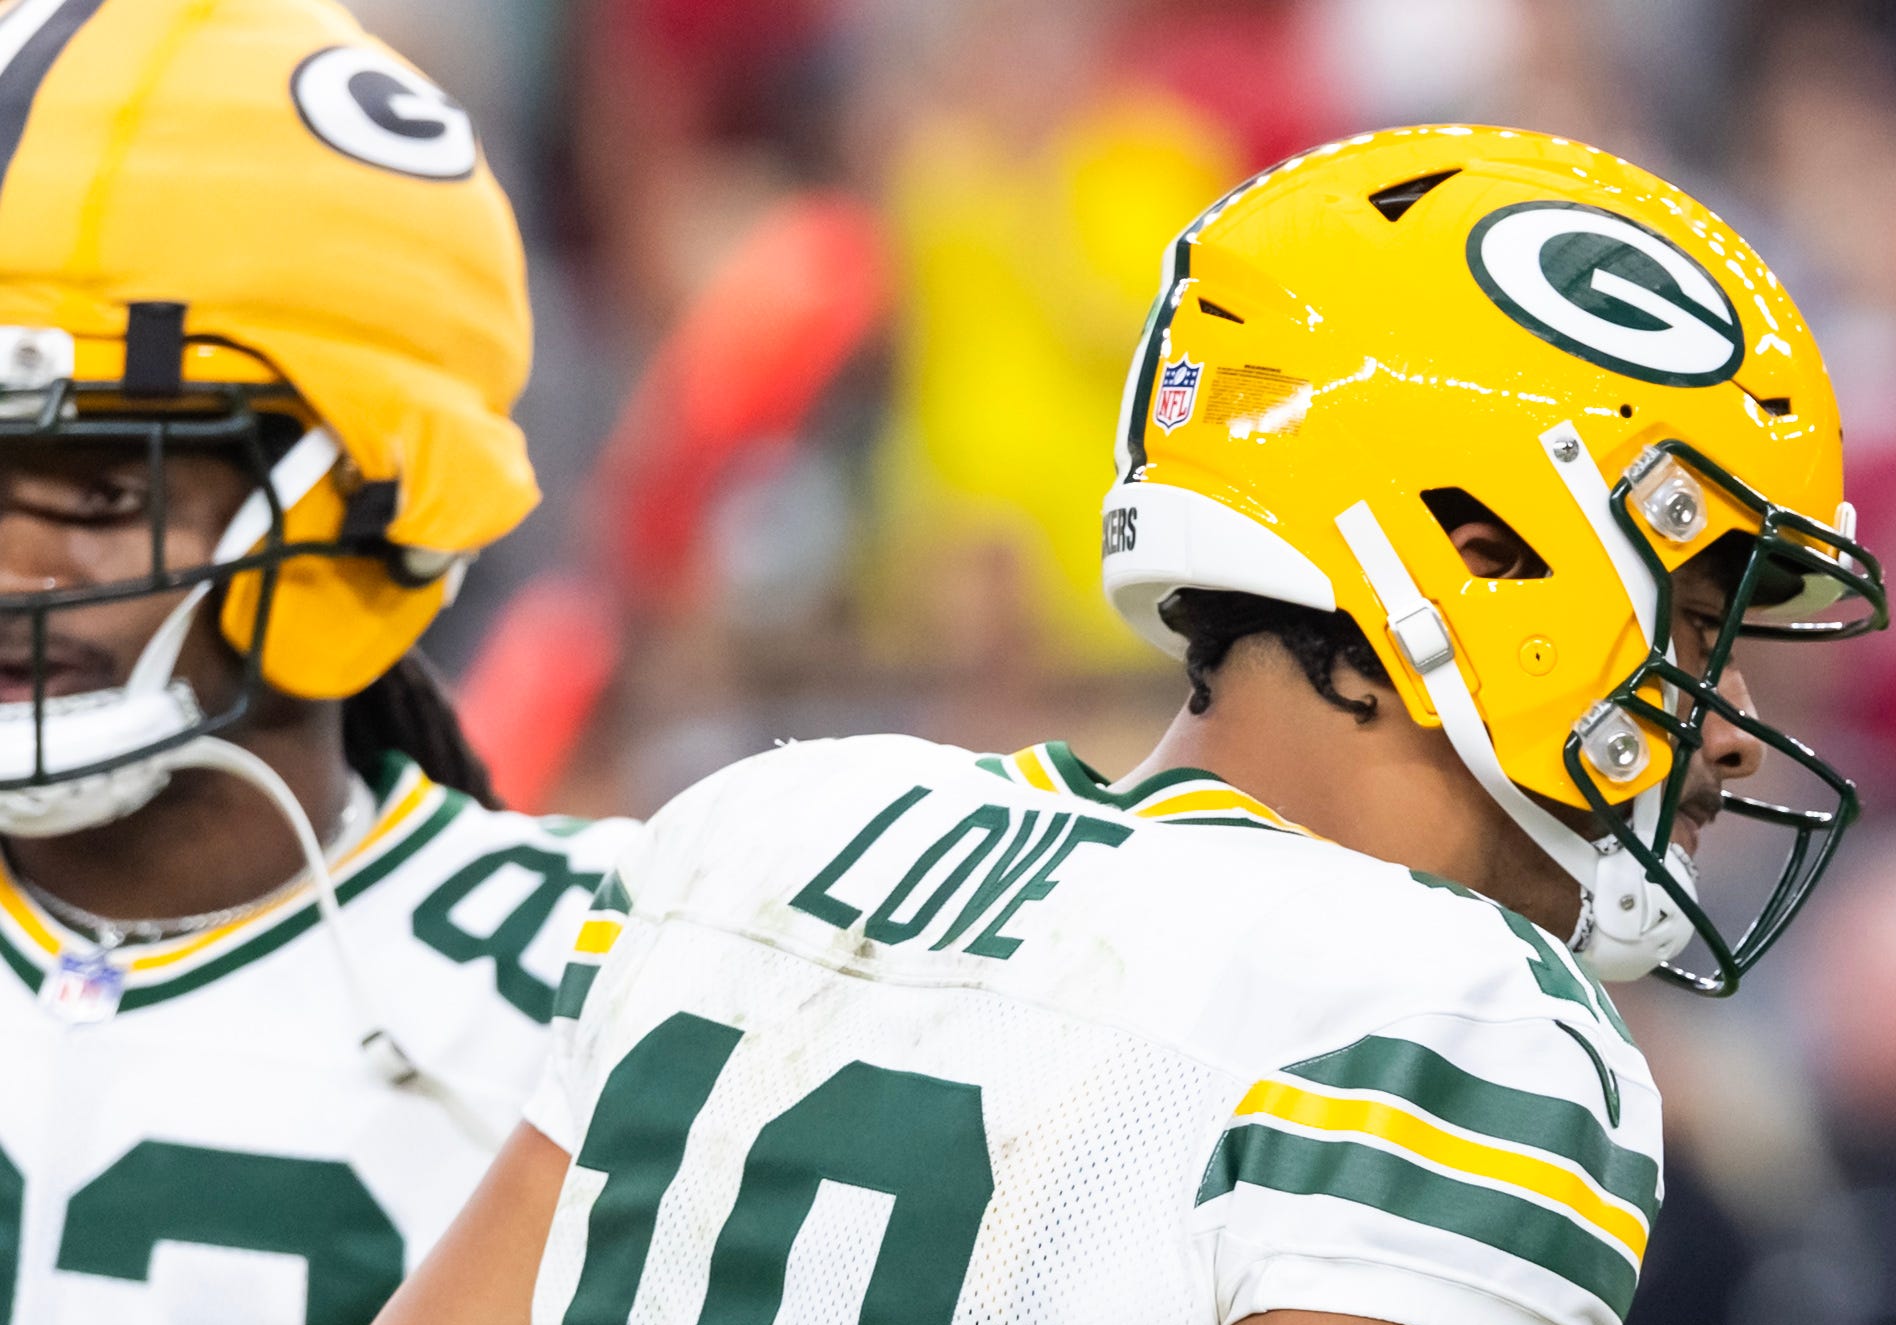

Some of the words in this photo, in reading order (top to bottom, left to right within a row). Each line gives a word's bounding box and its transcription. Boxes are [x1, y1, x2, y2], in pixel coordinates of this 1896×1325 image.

[296, 47, 476, 177] G
[1480, 208, 1735, 375] G
[1158, 390, 1187, 420] NFL
[787, 785, 1135, 961] LOVE
